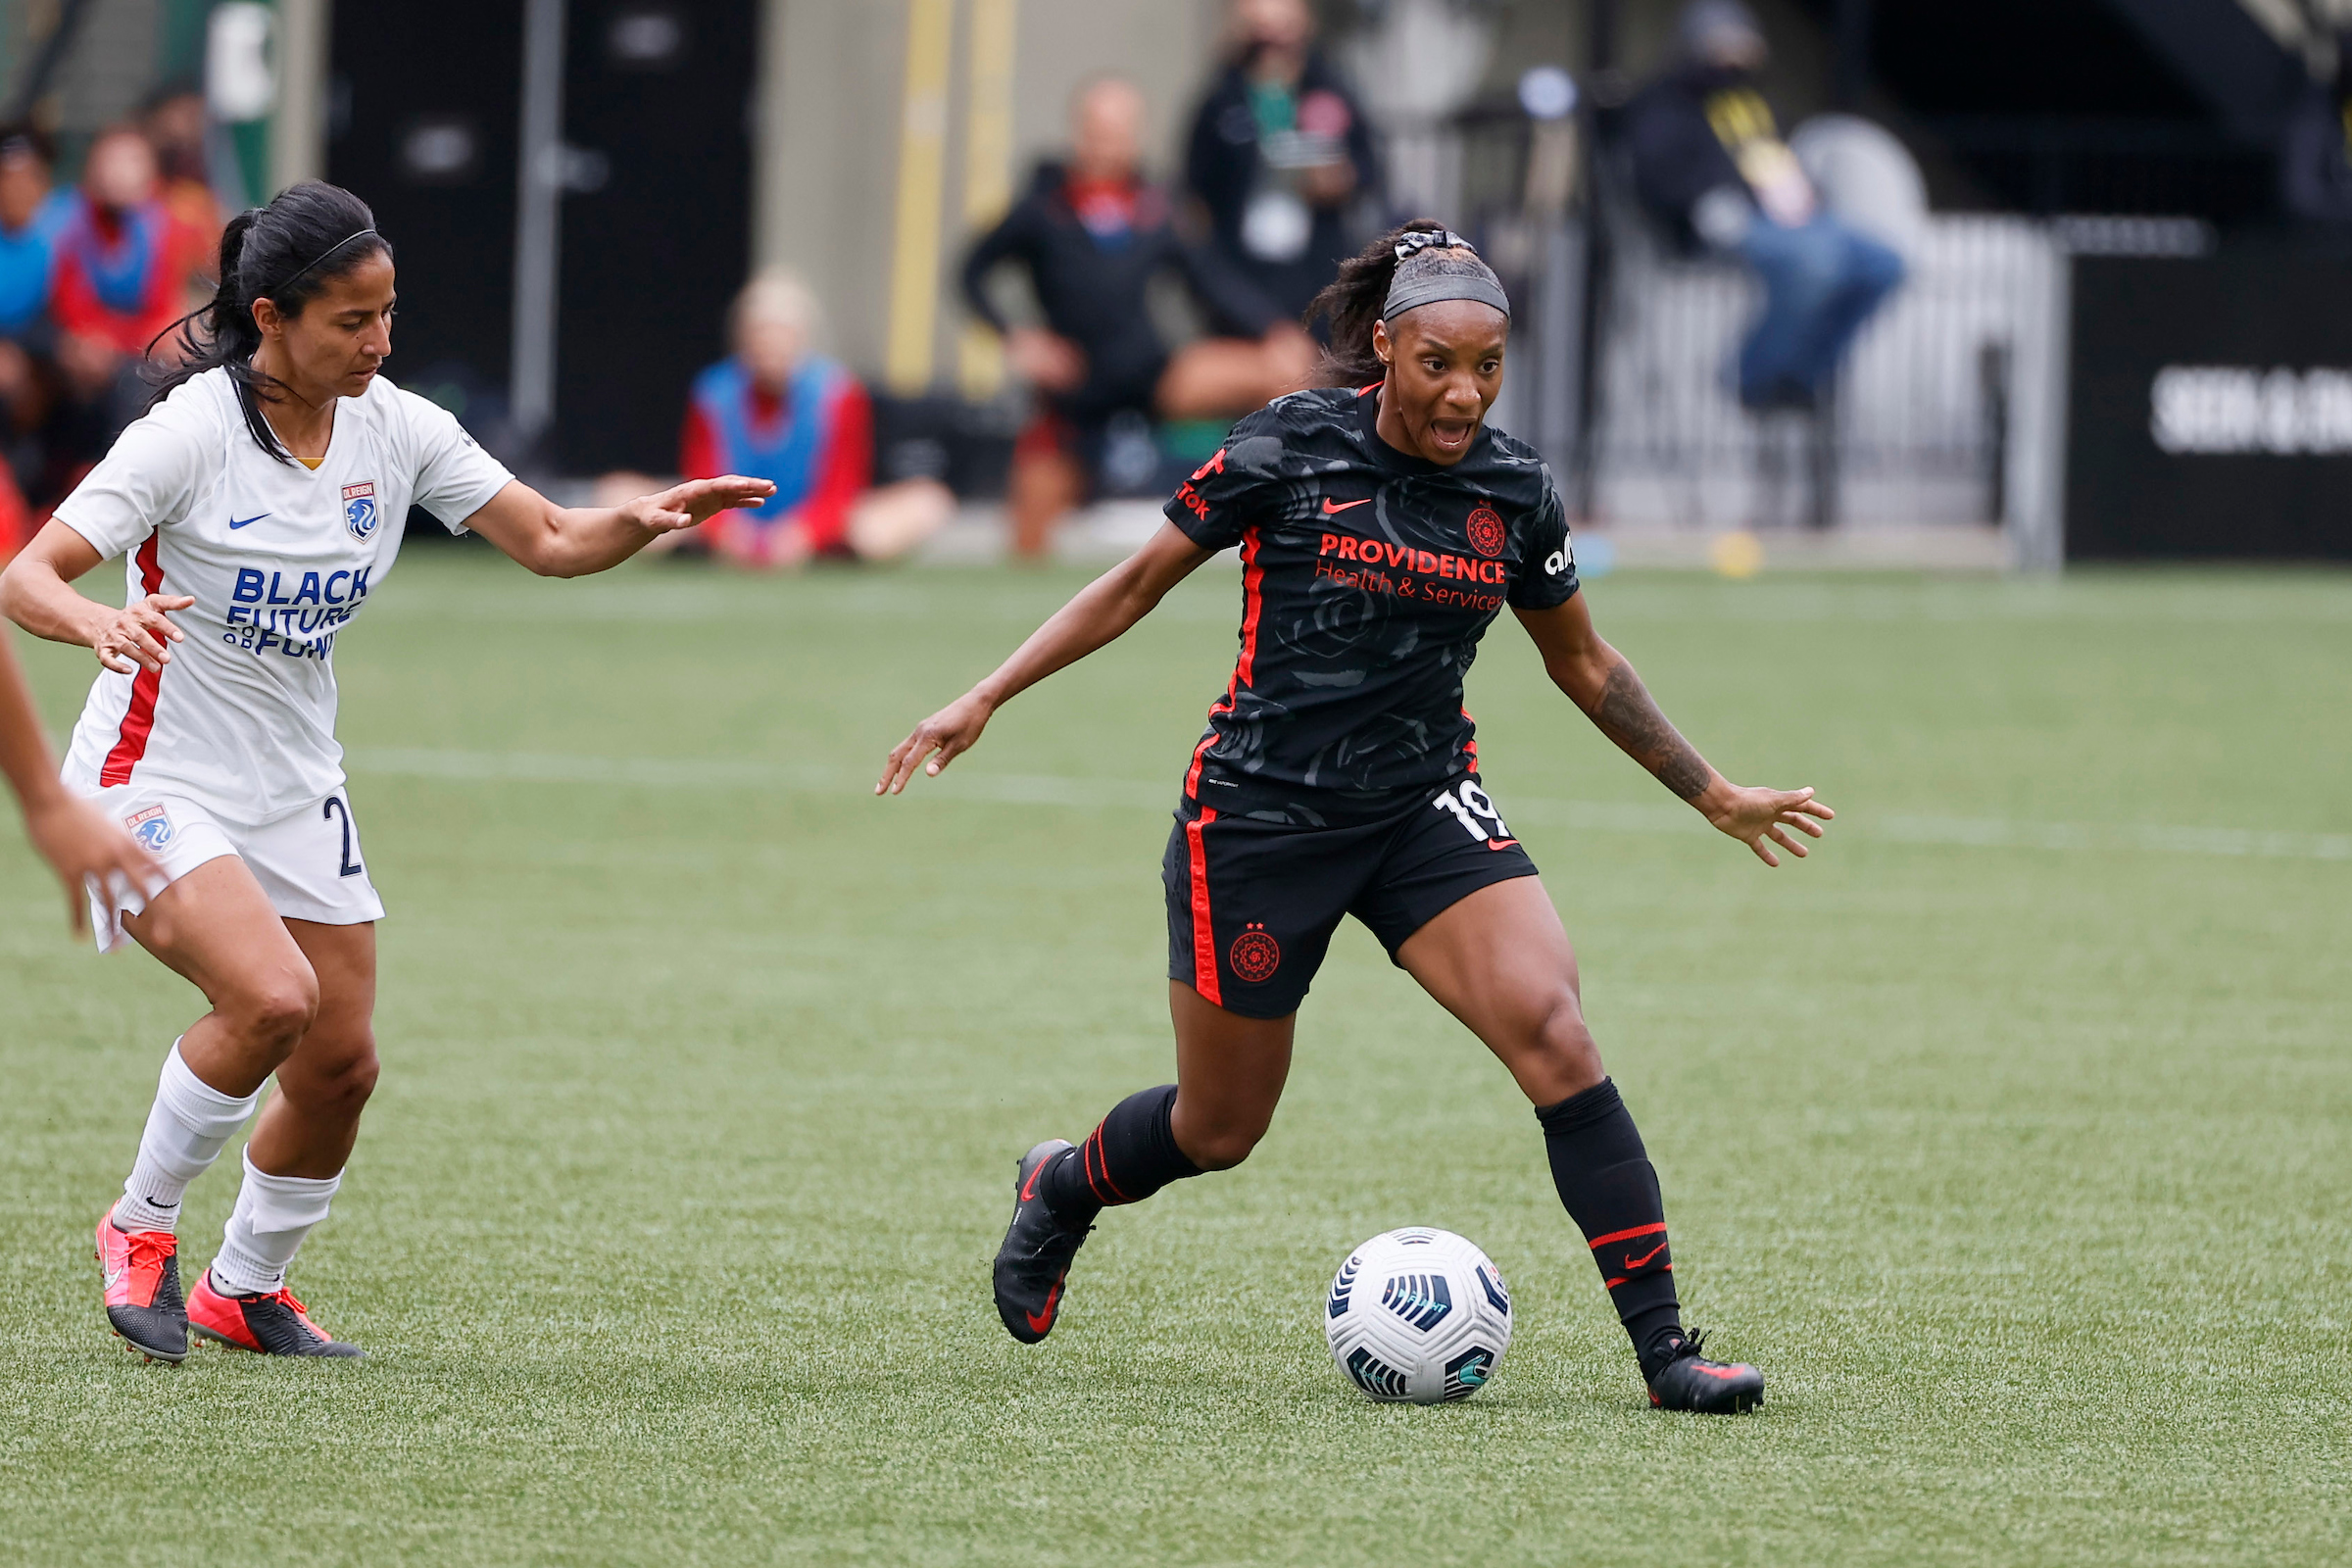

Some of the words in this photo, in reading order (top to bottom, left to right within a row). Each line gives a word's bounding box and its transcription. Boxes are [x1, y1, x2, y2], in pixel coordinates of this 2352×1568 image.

[352, 483, 372, 497] REIGN
[1318, 533, 1505, 584] PROVIDENCE
[231, 565, 372, 605] BLACK
[1315, 559, 1393, 594] Health
[1397, 577, 1416, 598] &
[226, 601, 362, 636] FUTURE
[255, 628, 337, 661] FUN
[138, 806, 164, 822] REIGN
[1433, 779, 1509, 842] 19
[323, 795, 362, 879] 2
